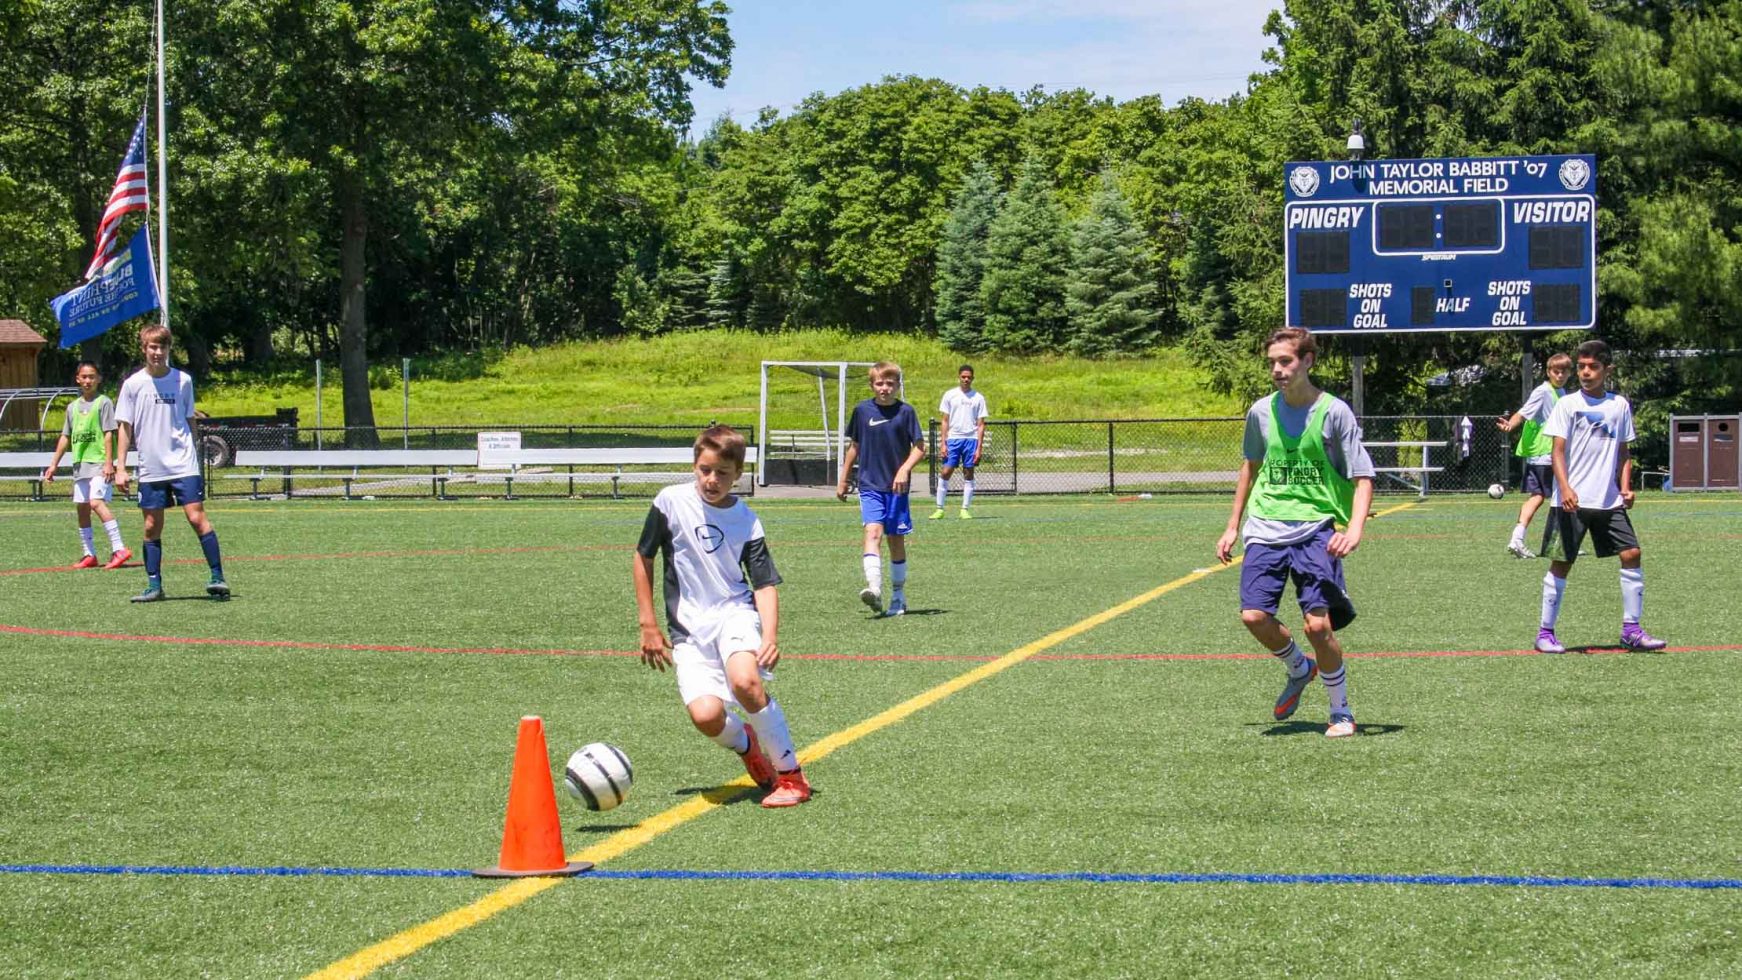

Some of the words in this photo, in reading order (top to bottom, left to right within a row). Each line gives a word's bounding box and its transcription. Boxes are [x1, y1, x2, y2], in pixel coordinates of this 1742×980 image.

[1330, 165, 1375, 183] JOHN
[1381, 162, 1444, 179] TAYLOR
[1450, 161, 1519, 176] BABBITT
[1523, 160, 1547, 178] '07
[1369, 179, 1458, 195] MEMORIAL
[1464, 178, 1509, 193] FIELD
[1289, 206, 1365, 229] PINGRY
[1513, 201, 1590, 224] VISITOR
[1349, 283, 1392, 298] SHOTS
[1487, 280, 1531, 295] SHOTS
[1360, 299, 1382, 313] ON
[1435, 297, 1470, 312] HALF
[1499, 296, 1520, 311] ON
[1353, 313, 1388, 328] GOAL
[1491, 311, 1527, 326] GOAL
[1287, 476, 1325, 485] SOCCER
